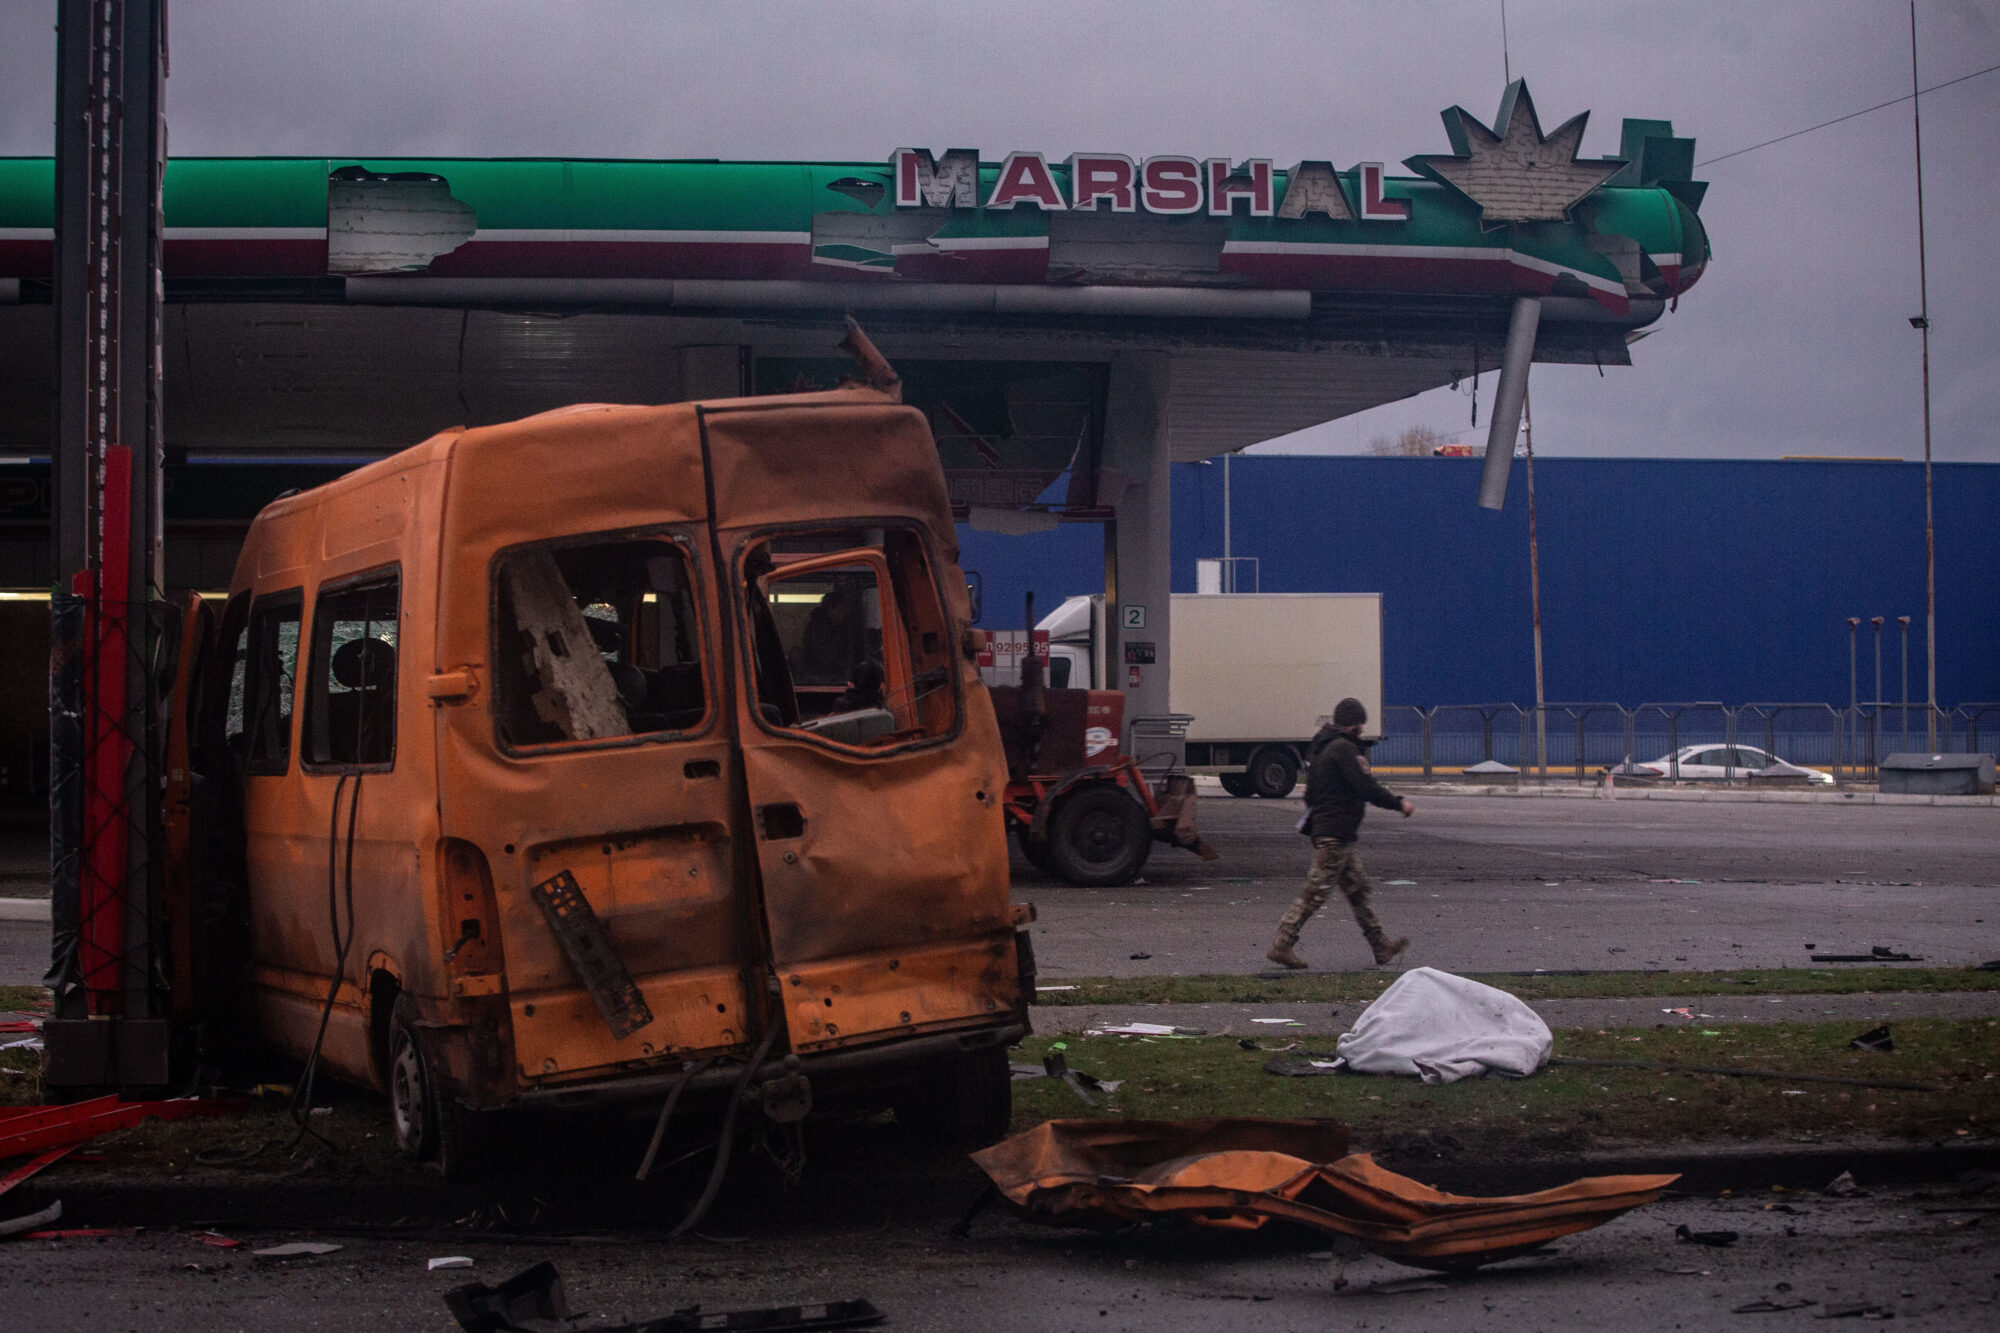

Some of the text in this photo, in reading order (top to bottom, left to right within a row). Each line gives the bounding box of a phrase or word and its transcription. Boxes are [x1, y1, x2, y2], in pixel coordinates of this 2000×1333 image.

[896, 147, 1410, 220] MARSHAL
[1129, 610, 1140, 624] 2
[996, 642, 1012, 653] 92
[1015, 642, 1029, 653] 95
[1033, 641, 1049, 653] 95
